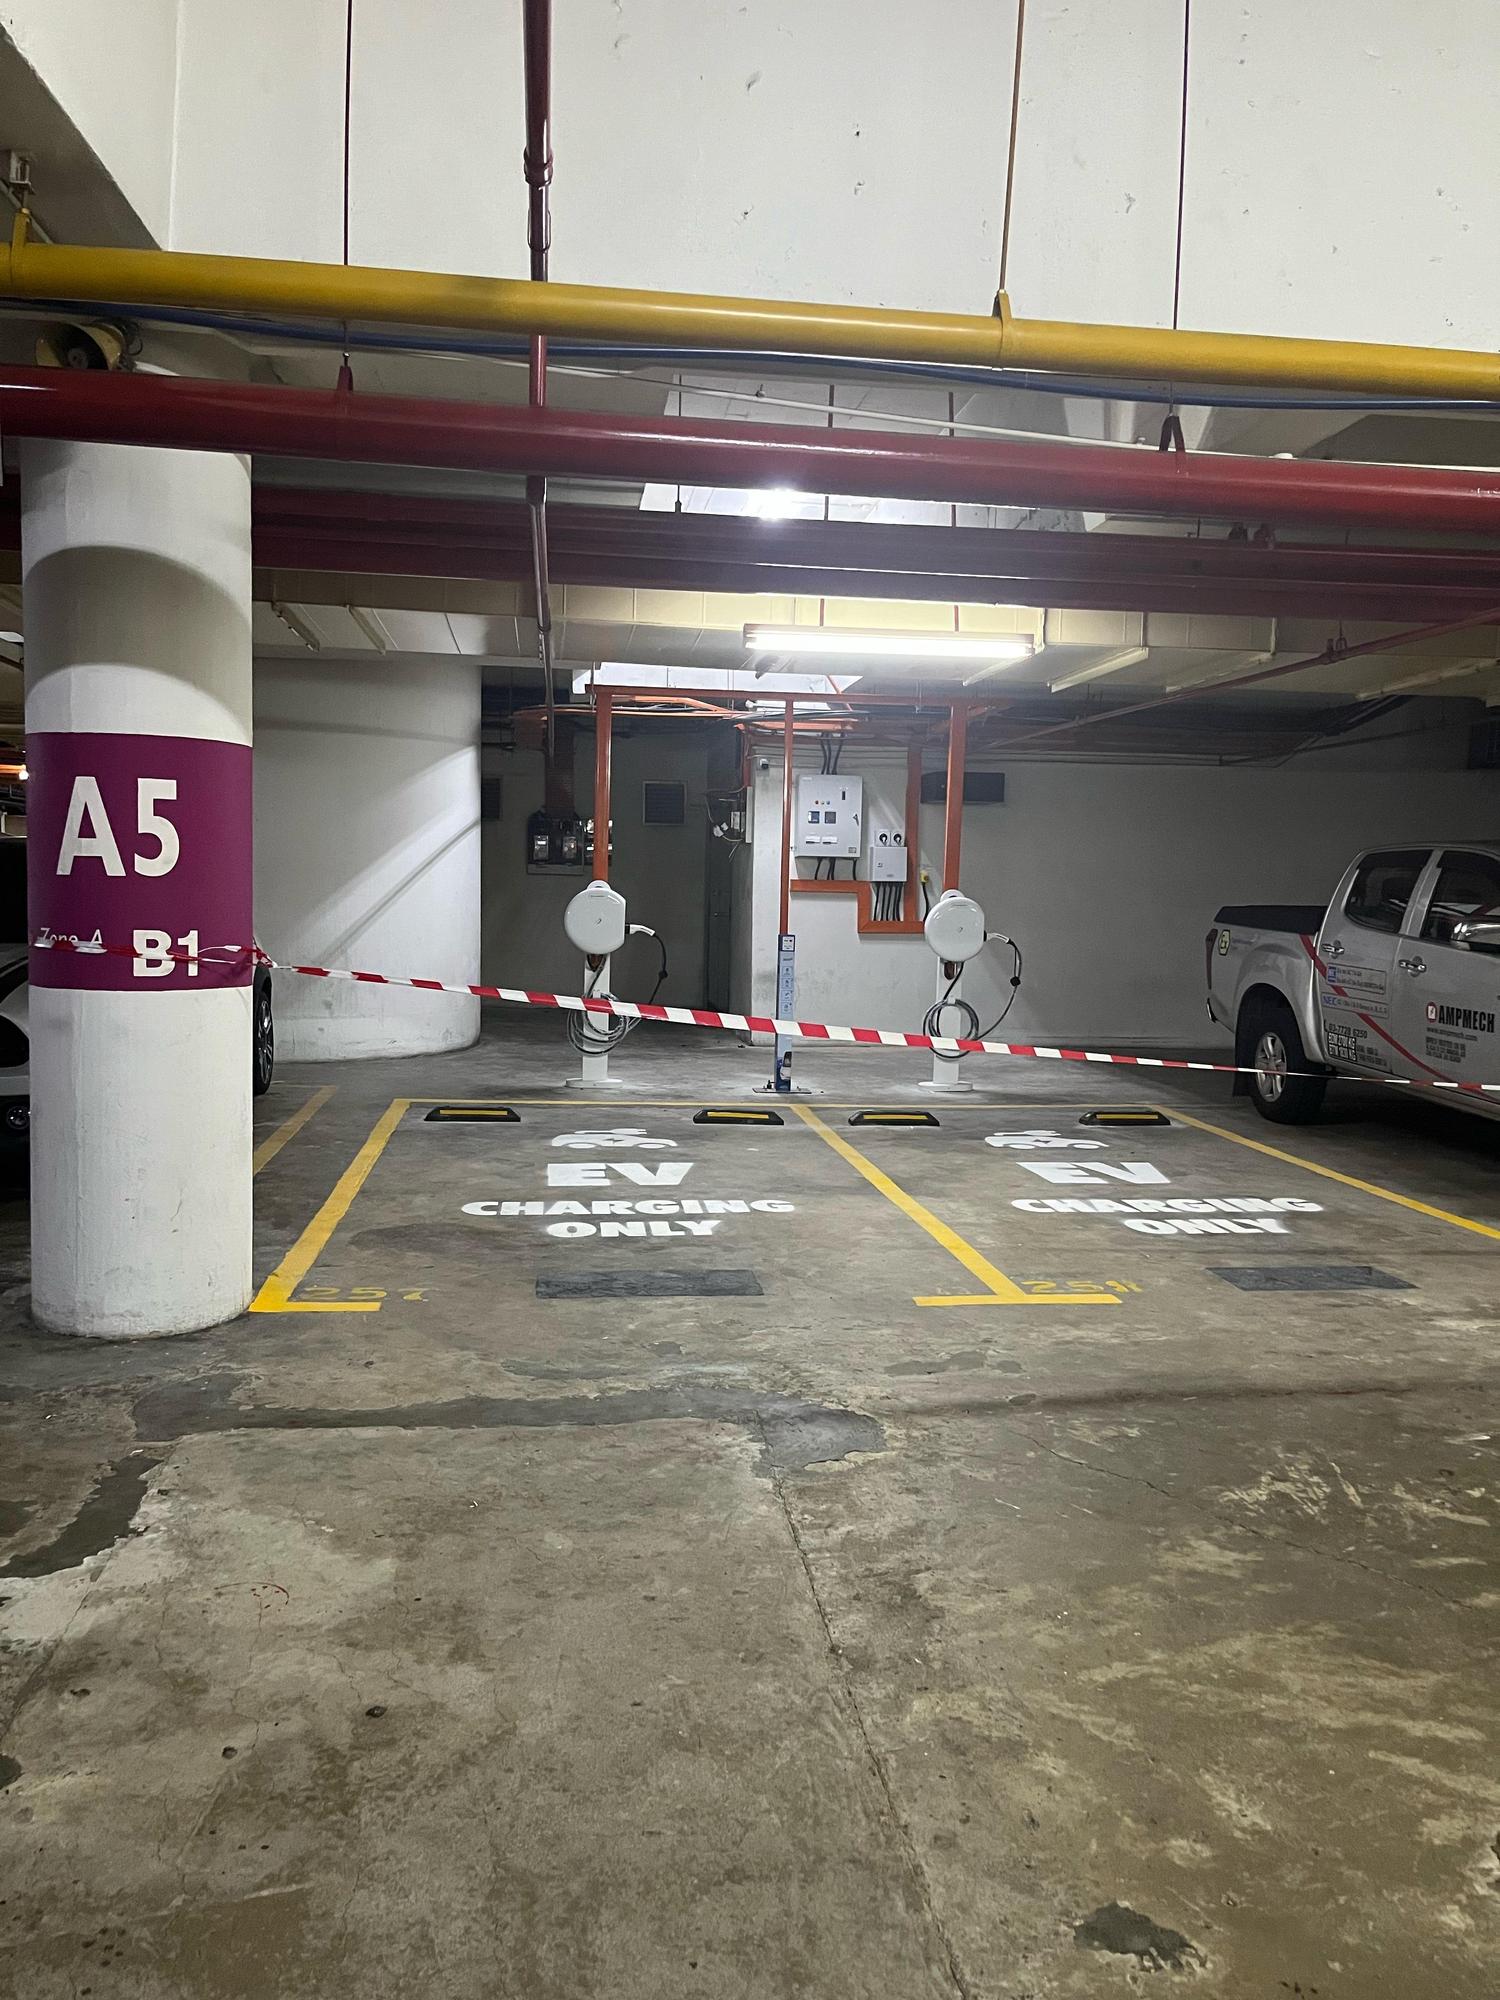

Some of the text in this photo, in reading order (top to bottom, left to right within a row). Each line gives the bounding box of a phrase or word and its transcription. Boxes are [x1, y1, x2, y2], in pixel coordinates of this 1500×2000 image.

[56, 776, 180, 877] A5
[90, 929, 104, 945] A
[132, 929, 199, 977] B1
[1438, 1005, 1495, 1033] AMPMECH
[546, 1161, 694, 1187] EV
[1016, 1161, 1171, 1185] EV
[460, 1199, 797, 1216] CHARGING
[1010, 1197, 1324, 1213] CHARGING
[546, 1219, 722, 1239] ONLY
[1123, 1218, 1291, 1235] ONLY
